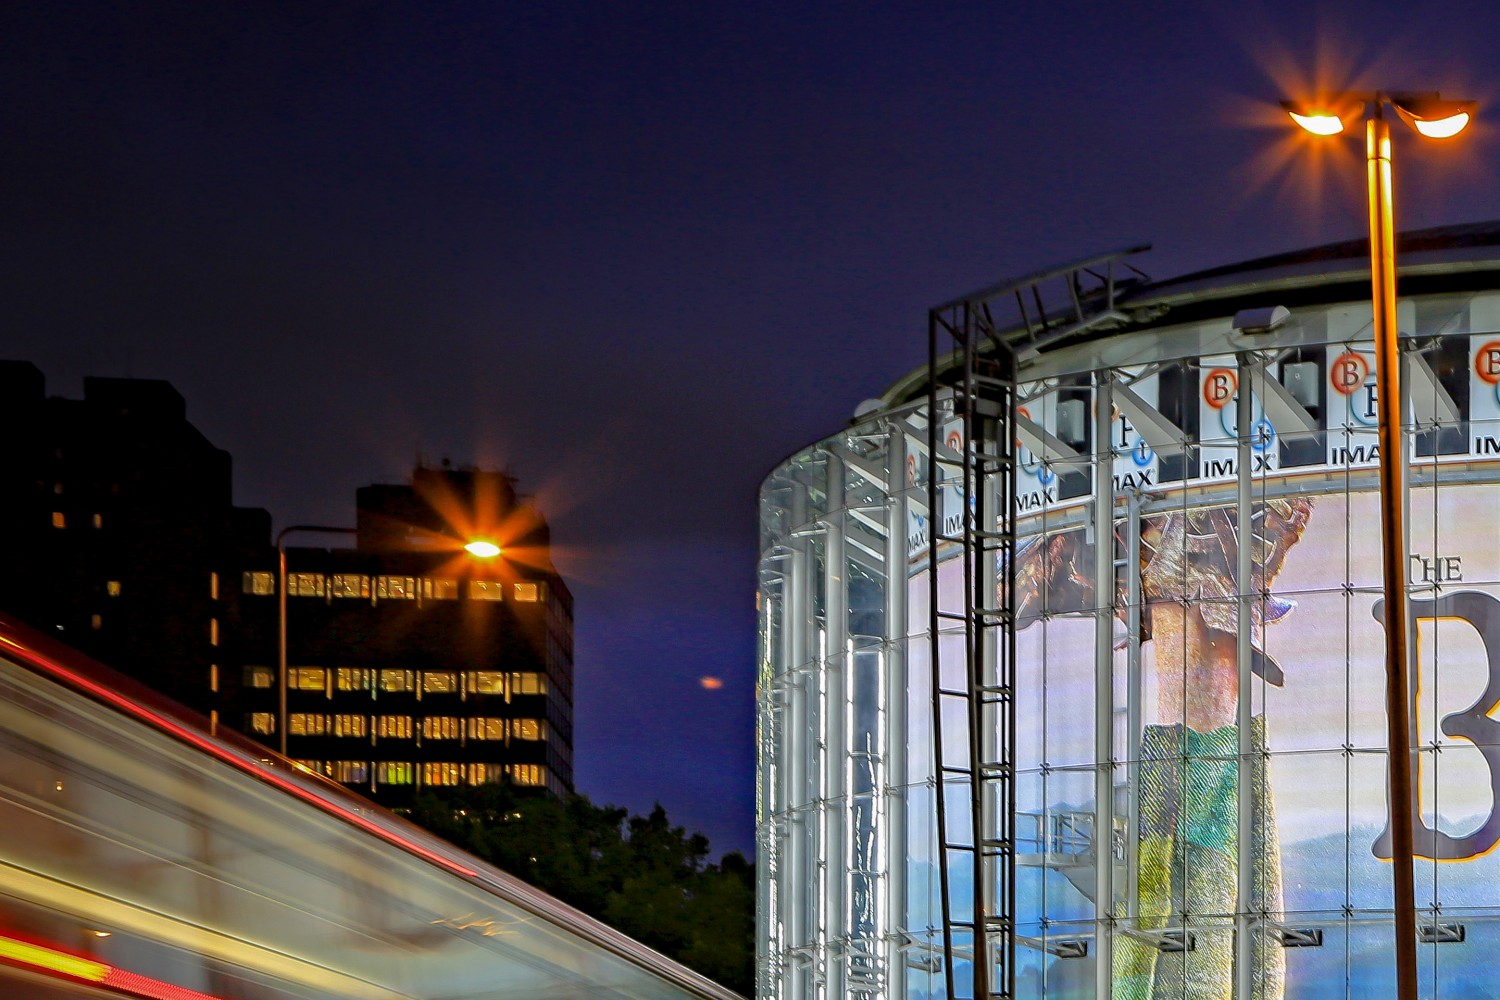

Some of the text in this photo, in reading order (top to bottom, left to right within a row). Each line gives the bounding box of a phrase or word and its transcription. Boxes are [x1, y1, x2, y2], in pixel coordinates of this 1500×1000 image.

[1203, 453, 1274, 479] IMX
[1331, 444, 1381, 466] IMA
[1016, 487, 1055, 512] MAX
[1409, 553, 1463, 584] THE
